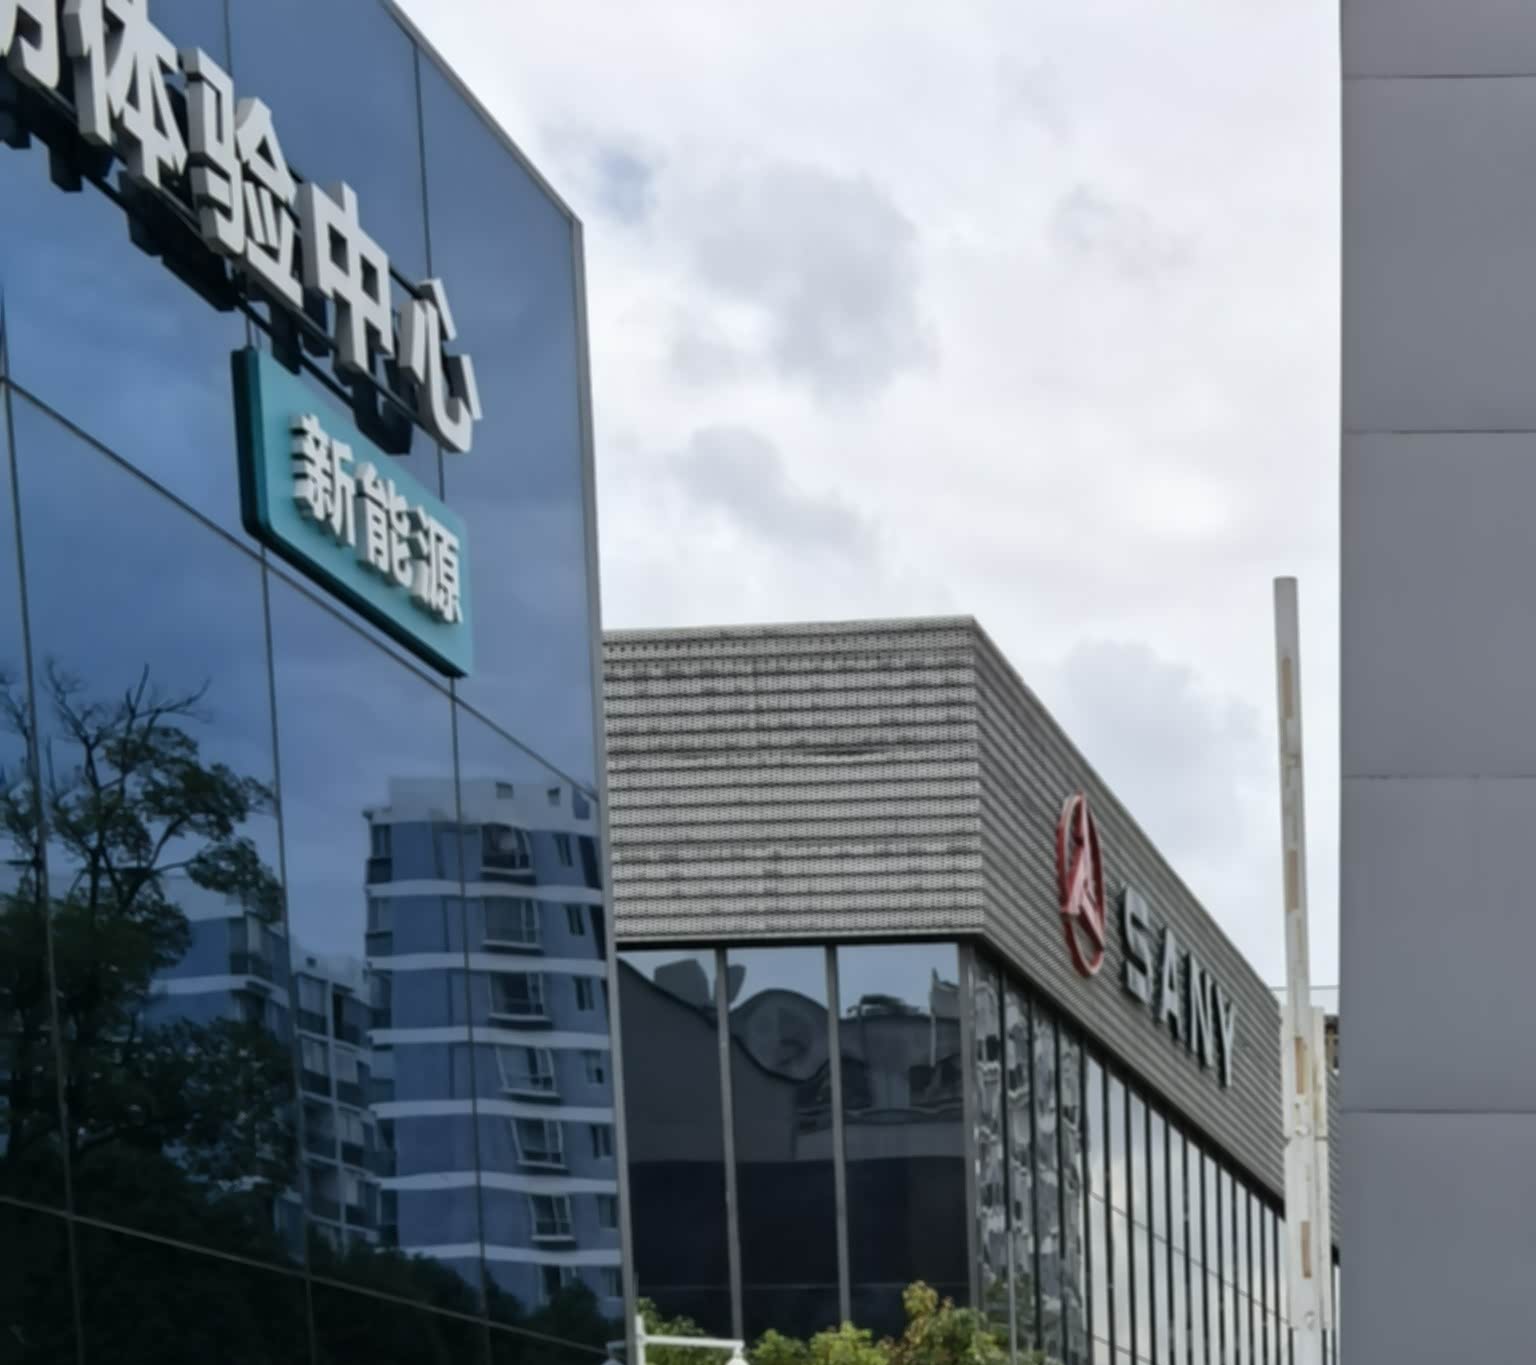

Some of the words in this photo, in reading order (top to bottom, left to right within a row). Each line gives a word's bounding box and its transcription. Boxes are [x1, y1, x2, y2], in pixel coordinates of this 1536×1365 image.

[290, 413, 463, 624] 新能源
[1118, 884, 1236, 1088] SANY
